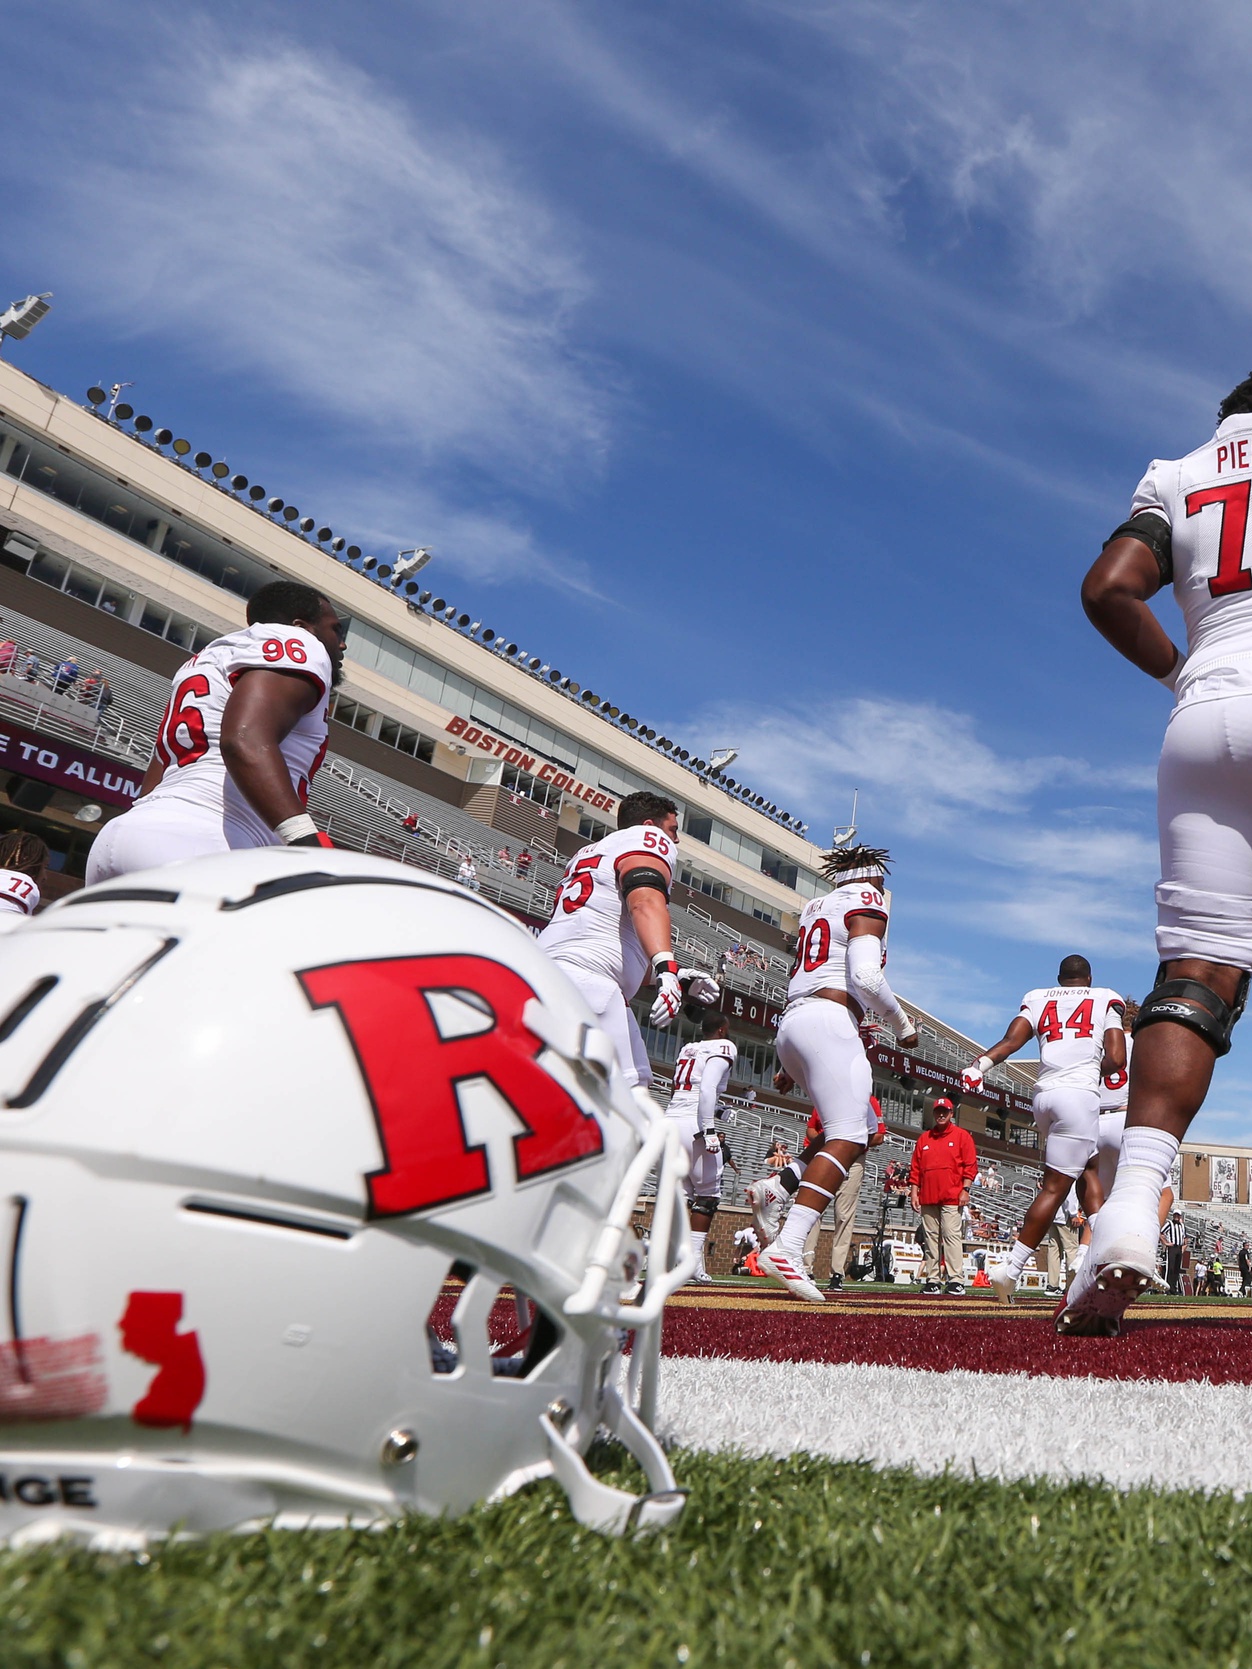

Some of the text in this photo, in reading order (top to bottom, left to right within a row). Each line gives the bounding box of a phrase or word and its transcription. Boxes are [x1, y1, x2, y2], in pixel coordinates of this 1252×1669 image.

[262, 638, 307, 663] 96
[20, 741, 59, 769] TO
[445, 715, 616, 813] BOSTON COLLEGE
[643, 831, 671, 856] 55
[9, 877, 33, 899] 77
[861, 891, 883, 906] 90
[1044, 988, 1091, 998] JOHNSON
[1037, 998, 1094, 1043] 44
[720, 1045, 731, 1055] 71
[878, 1053, 888, 1064] QTR
[675, 1058, 697, 1091] 71
[915, 1065, 945, 1082] WELCOME
[946, 1078, 954, 1086] TO
[294, 953, 605, 1222] R
